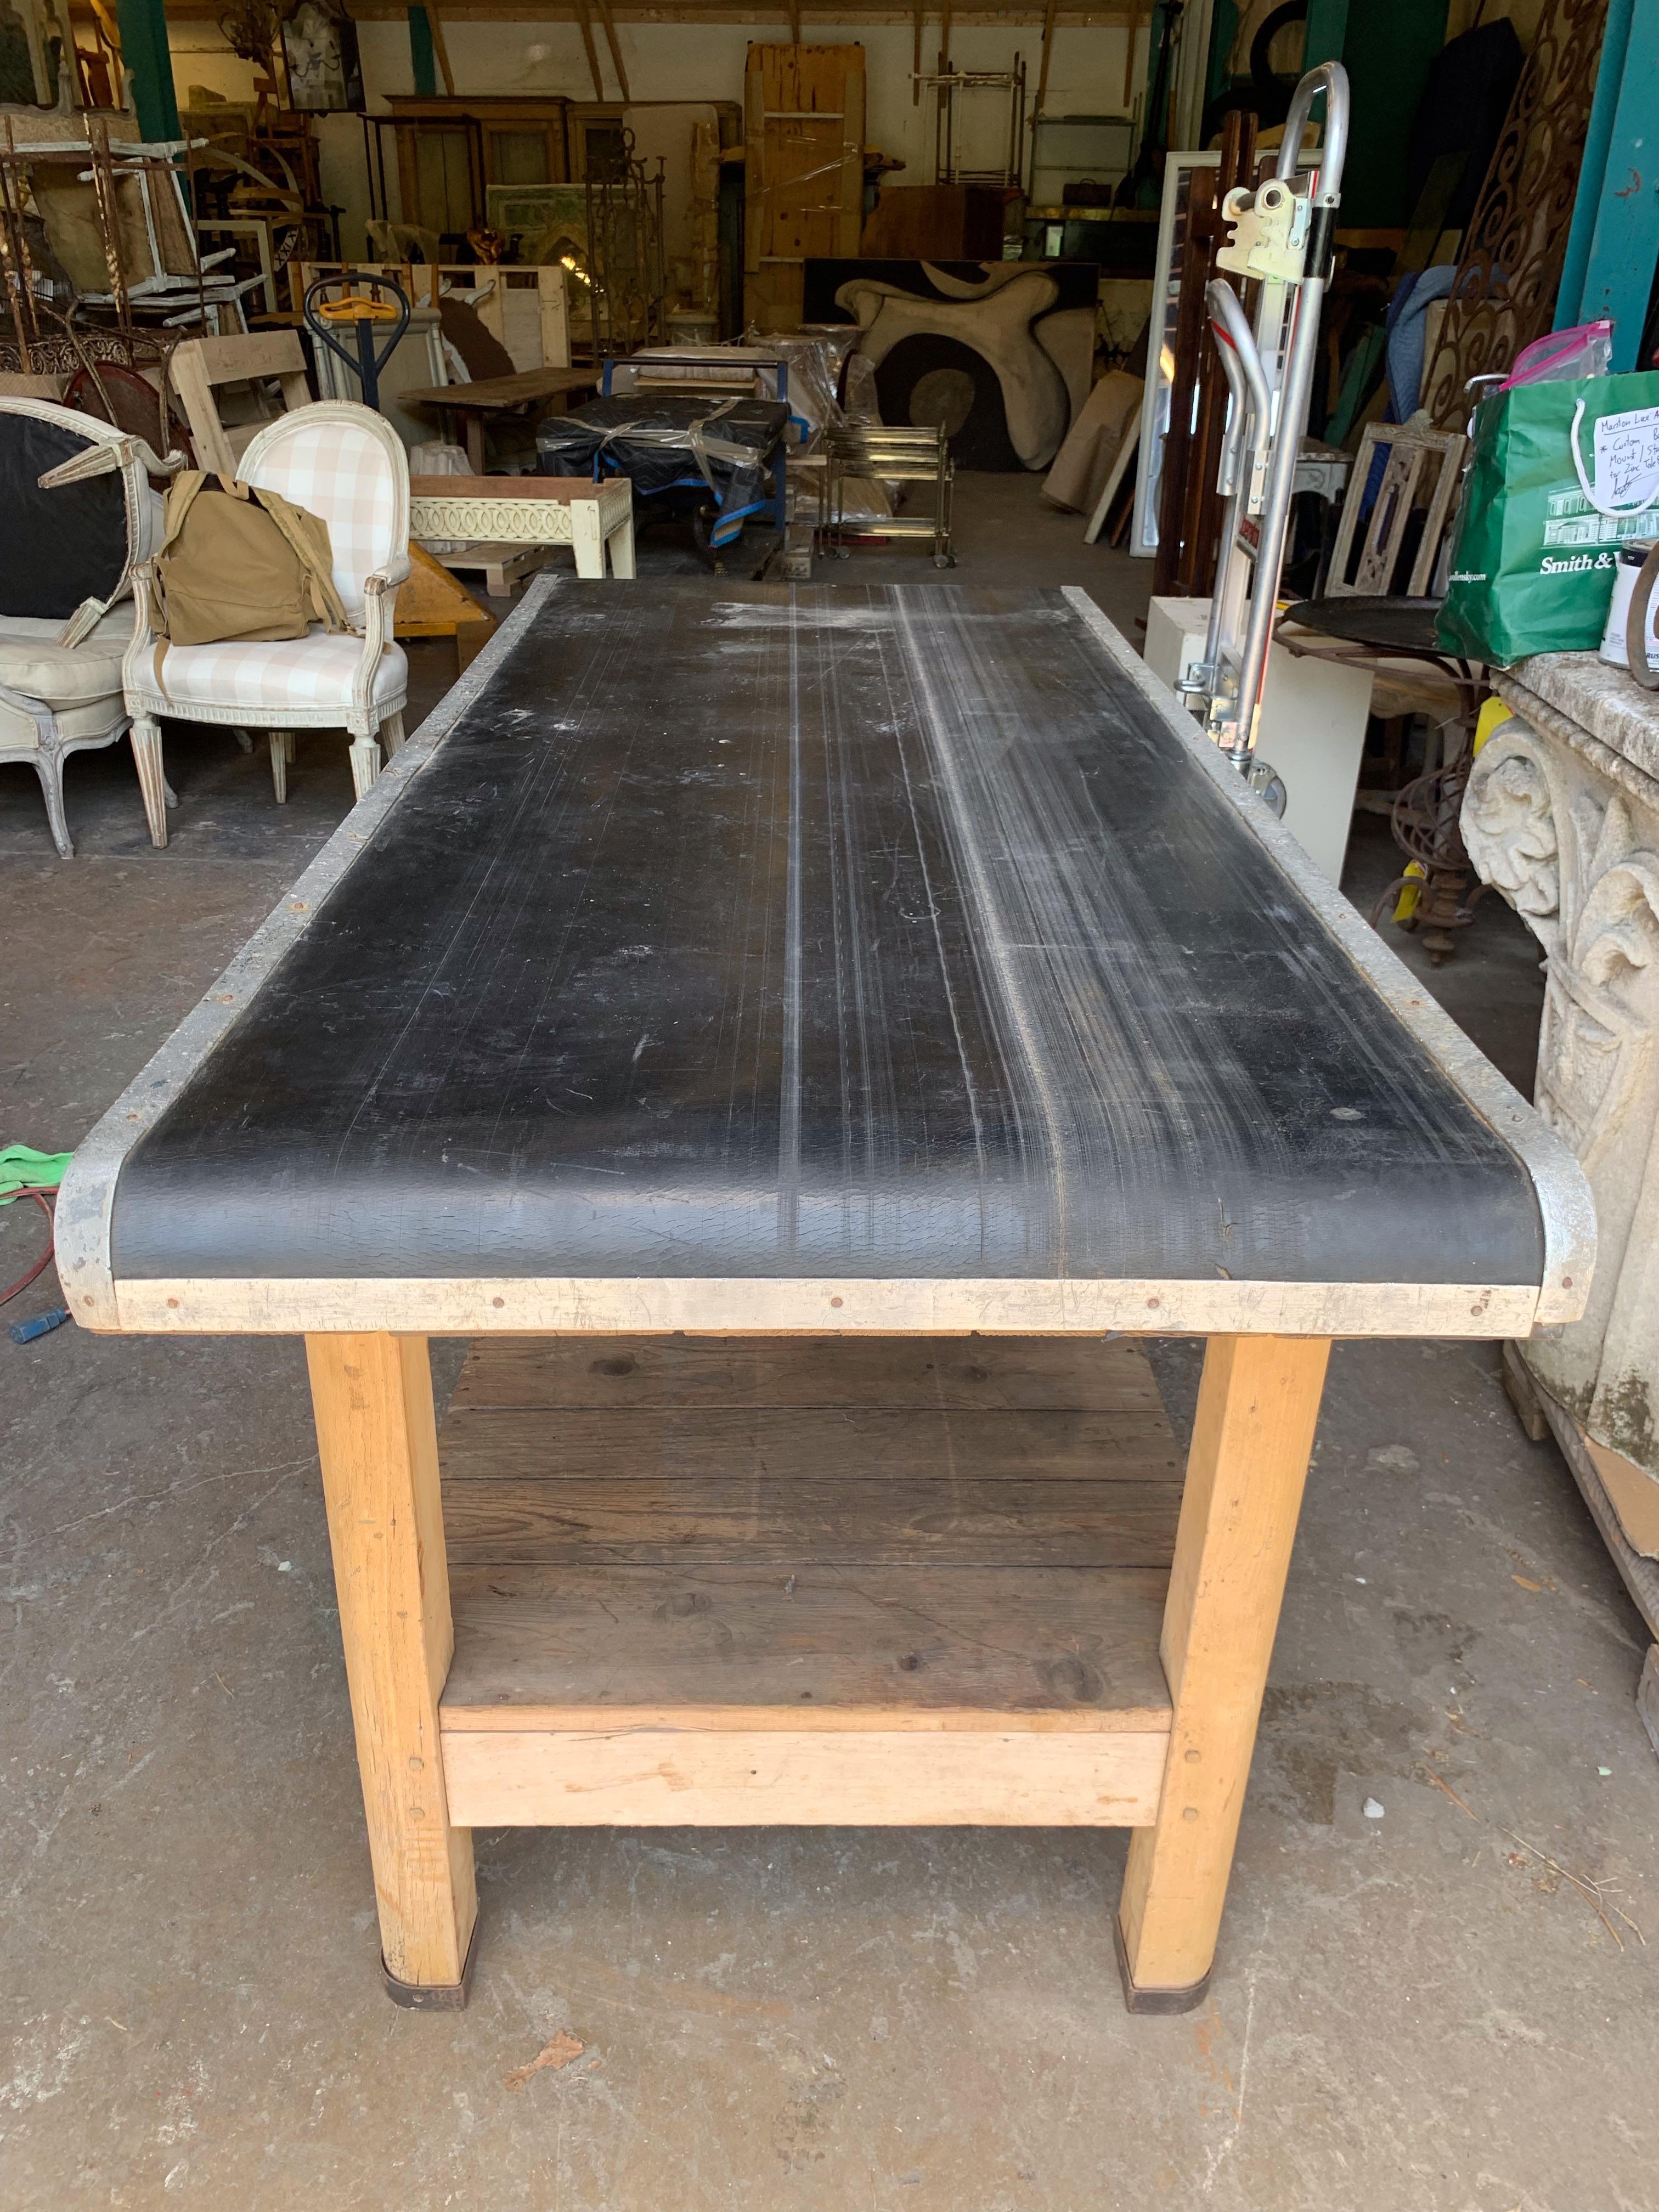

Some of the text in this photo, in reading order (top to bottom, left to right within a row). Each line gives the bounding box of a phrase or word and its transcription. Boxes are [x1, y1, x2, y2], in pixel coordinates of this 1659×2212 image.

[1601, 416, 1630, 432] Marston
[1613, 434, 1640, 450] Custom
[1609, 448, 1637, 467] Mount
[1623, 463, 1640, 474] Zinc
[1540, 554, 1592, 574] Smith
[1594, 552, 1614, 569] &
